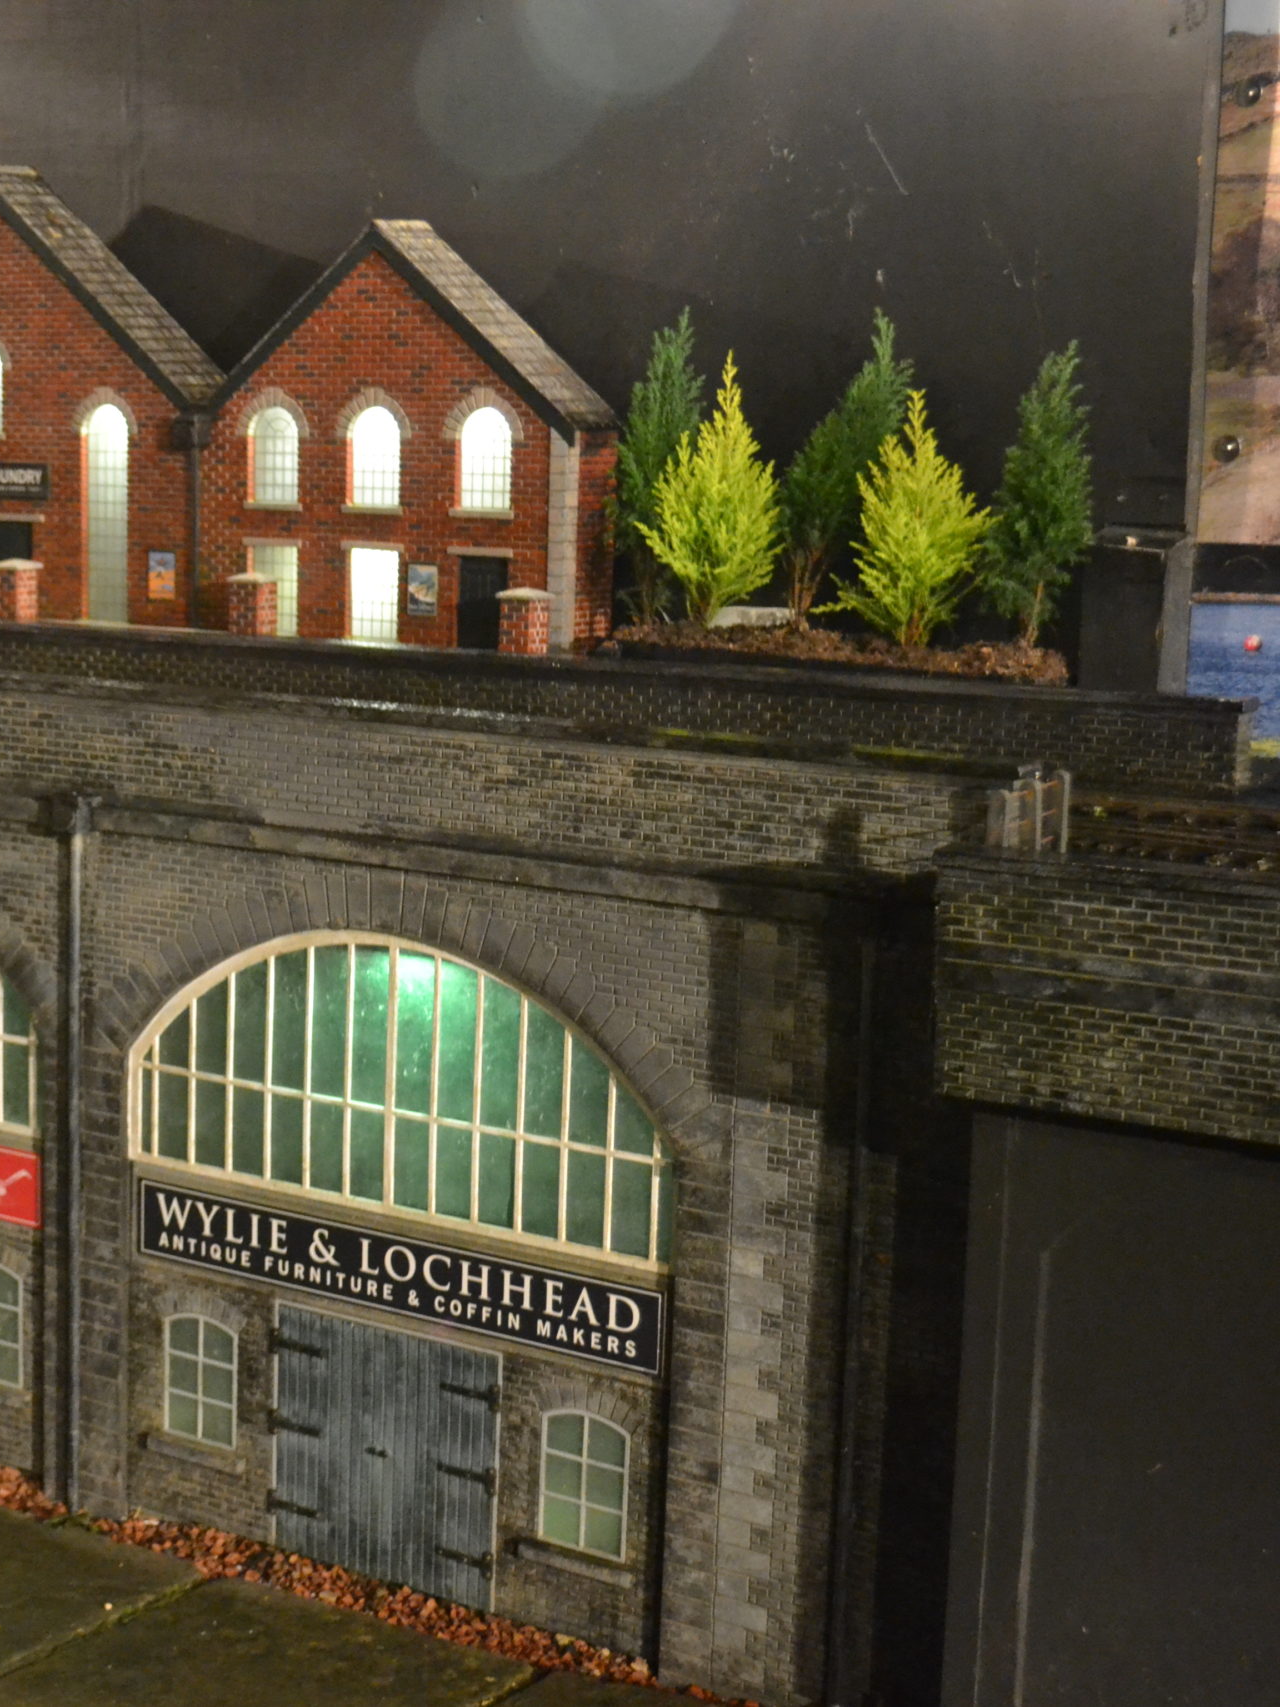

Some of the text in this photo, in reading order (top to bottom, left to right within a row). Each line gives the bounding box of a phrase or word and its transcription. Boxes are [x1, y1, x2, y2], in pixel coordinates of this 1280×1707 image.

[155, 1191, 641, 1336] WYLIE & LOCHHEAD
[157, 1230, 638, 1359] ANTIQUE FURNITURE & COFFIN MAKERS
